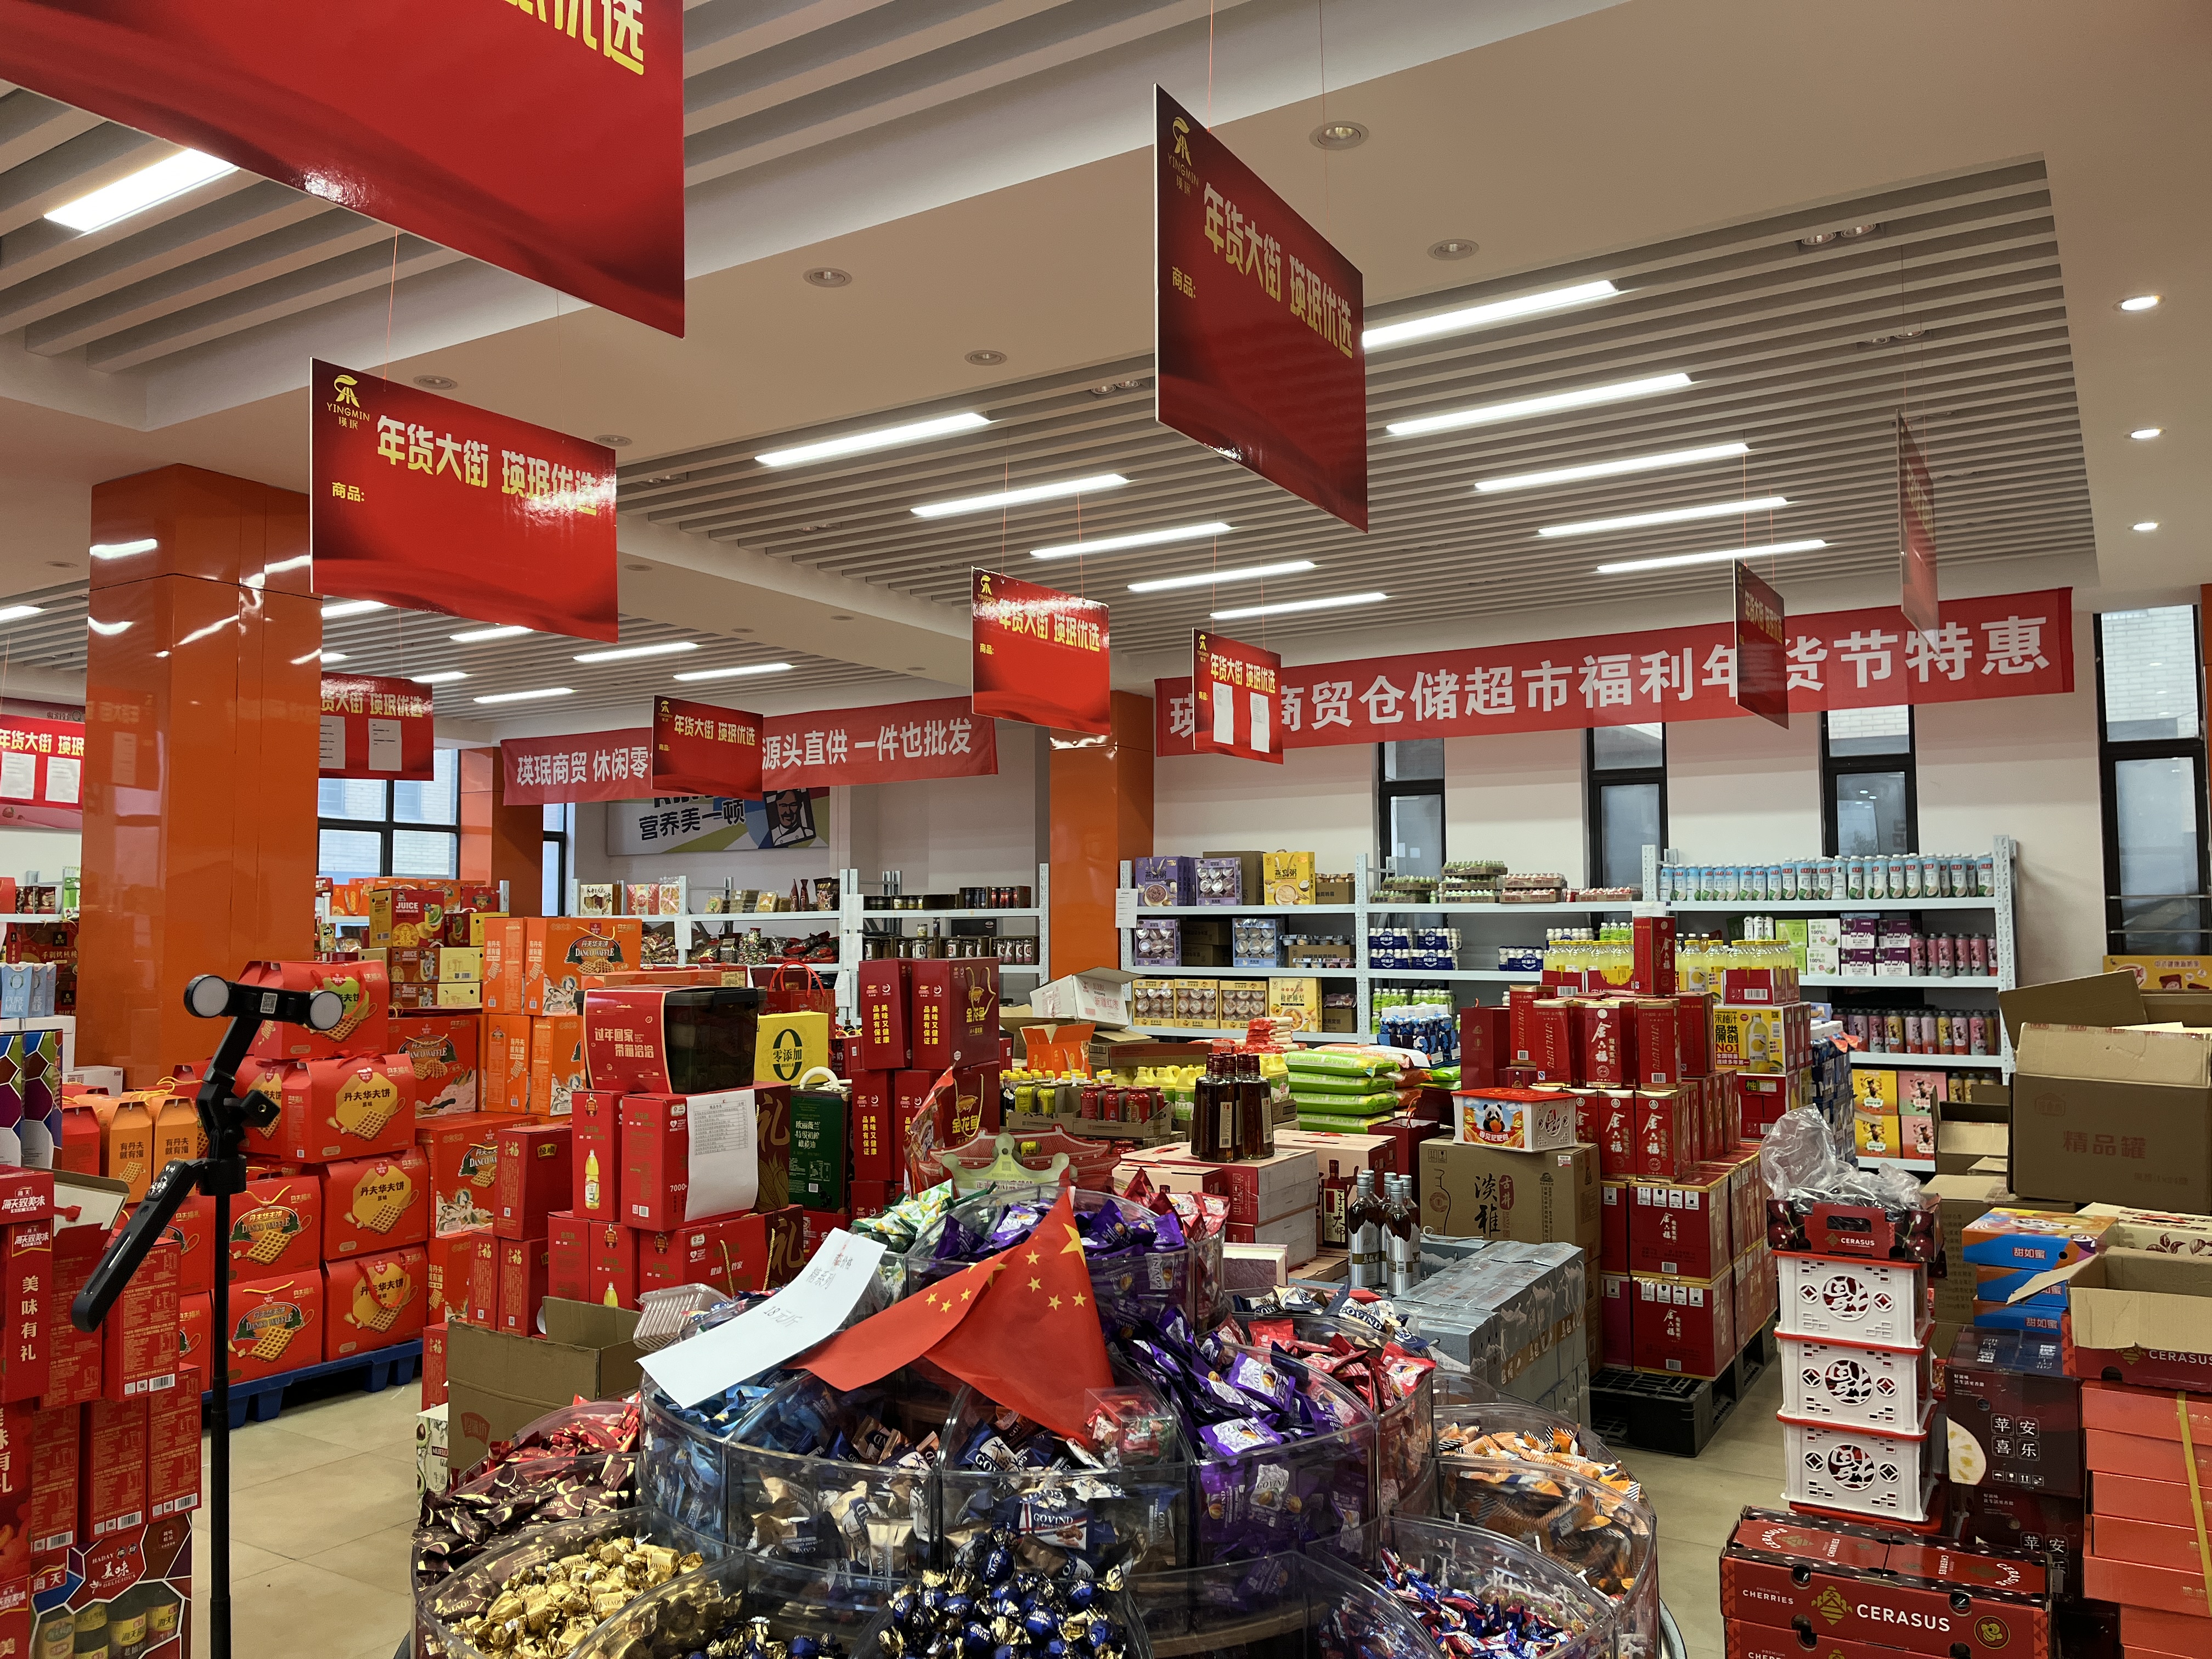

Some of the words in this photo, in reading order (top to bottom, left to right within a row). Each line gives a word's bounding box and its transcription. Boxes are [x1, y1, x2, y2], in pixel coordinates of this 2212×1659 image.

[503, 0, 644, 75] 优选
[1168, 153, 1199, 188] YINGMIN
[1204, 182, 1281, 302] 年货大街
[1289, 254, 1353, 359] 瑛珉优选
[1172, 266, 1197, 299] 商品:
[326, 402, 370, 421] YINGMIN
[338, 416, 359, 430] 瑛珉
[376, 415, 488, 488] 年货大街
[501, 449, 597, 516] 瑛珉优选
[331, 482, 365, 503] 商品:
[1053, 612, 1100, 652] 瑛珉优选
[979, 642, 994, 655] 商品:
[1169, 615, 2050, 738] 瑛商贸仓储超市福利年货节特惠
[1210, 652, 1243, 686] 年货大街
[1245, 662, 1276, 694] 瑛珉优选
[369, 692, 423, 718] 瑛珉优选
[0, 728, 52, 753] 年货大街
[674, 714, 714, 740] 年货大街
[718, 721, 755, 746] 瑛珉优选
[761, 728, 848, 771] 源头直供
[854, 717, 972, 762] 一件也批发
[516, 751, 588, 787] 瑛珉商贸
[592, 746, 653, 782] 休闲零
[639, 799, 746, 841] 营养美一顿
[575, 948, 595, 957] DANCO
[595, 947, 614, 957] WAFFLE
[4, 1003, 24, 1012] MILK
[5, 996, 24, 1005] PURE
[873, 1005, 882, 1045] 品质有保证
[881, 1004, 890, 1044] 美味又健康
[923, 1005, 931, 1045] 品质有保证
[1715, 1025, 1738, 1034] 品类
[594, 1028, 634, 1042] 过年回家
[1591, 1021, 1612, 1063] 金六福
[1715, 1034, 1738, 1043] 原创
[425, 1047, 448, 1057] WAFFLE
[614, 1043, 655, 1059] 带箱洽洽
[772, 1048, 803, 1063] 零添加
[1545, 1023, 1555, 1069] JINLIUFU
[1651, 1024, 1660, 1071] JINLIUFU
[343, 1087, 391, 1102] 丹夫华夫饼
[165, 1137, 190, 1148] 有丹夫
[861, 1115, 870, 1156] 品质有保证
[869, 1115, 878, 1156] 美味又健康
[1605, 1111, 1626, 1153] 金六福
[1642, 1112, 1663, 1155] 金六福
[120, 1141, 145, 1152] 有丹夫
[120, 1149, 145, 1160] 就有福
[165, 1146, 189, 1156] 就有福
[2063, 1130, 2147, 1159] 精品罐
[360, 1181, 405, 1198] 丹夫华夫饼
[1500, 1177, 1513, 1207] 古井
[1474, 1172, 1502, 1238] 淡雅
[249, 1210, 283, 1223] 丹夫华夫饼
[1659, 1212, 1673, 1239] 金六福
[1840, 1237, 1875, 1247] CERASUS
[2013, 1246, 2046, 1260] 甜如蜜
[19, 1275, 40, 1363] 美味有礼
[1340, 1306, 1383, 1331] GOVIND
[1663, 1308, 1678, 1336] 金六福
[2025, 1316, 2059, 1330] 甜如蜜
[1993, 1416, 2036, 1436] 苹安
[1995, 1438, 2038, 1459] 喜乐
[1257, 1478, 1289, 1490] GOVIND
[1032, 1511, 1074, 1526] GOVIND
[2023, 1535, 2066, 1555] 苹安
[92, 1552, 114, 1565] HADAY
[102, 1561, 129, 1579] 美味
[33, 1571, 63, 1592] 海天
[1756, 1586, 1780, 1594] PREMIUM
[1742, 1589, 1794, 1606] CHERRIES
[1856, 1603, 1951, 1633] CERASUS
